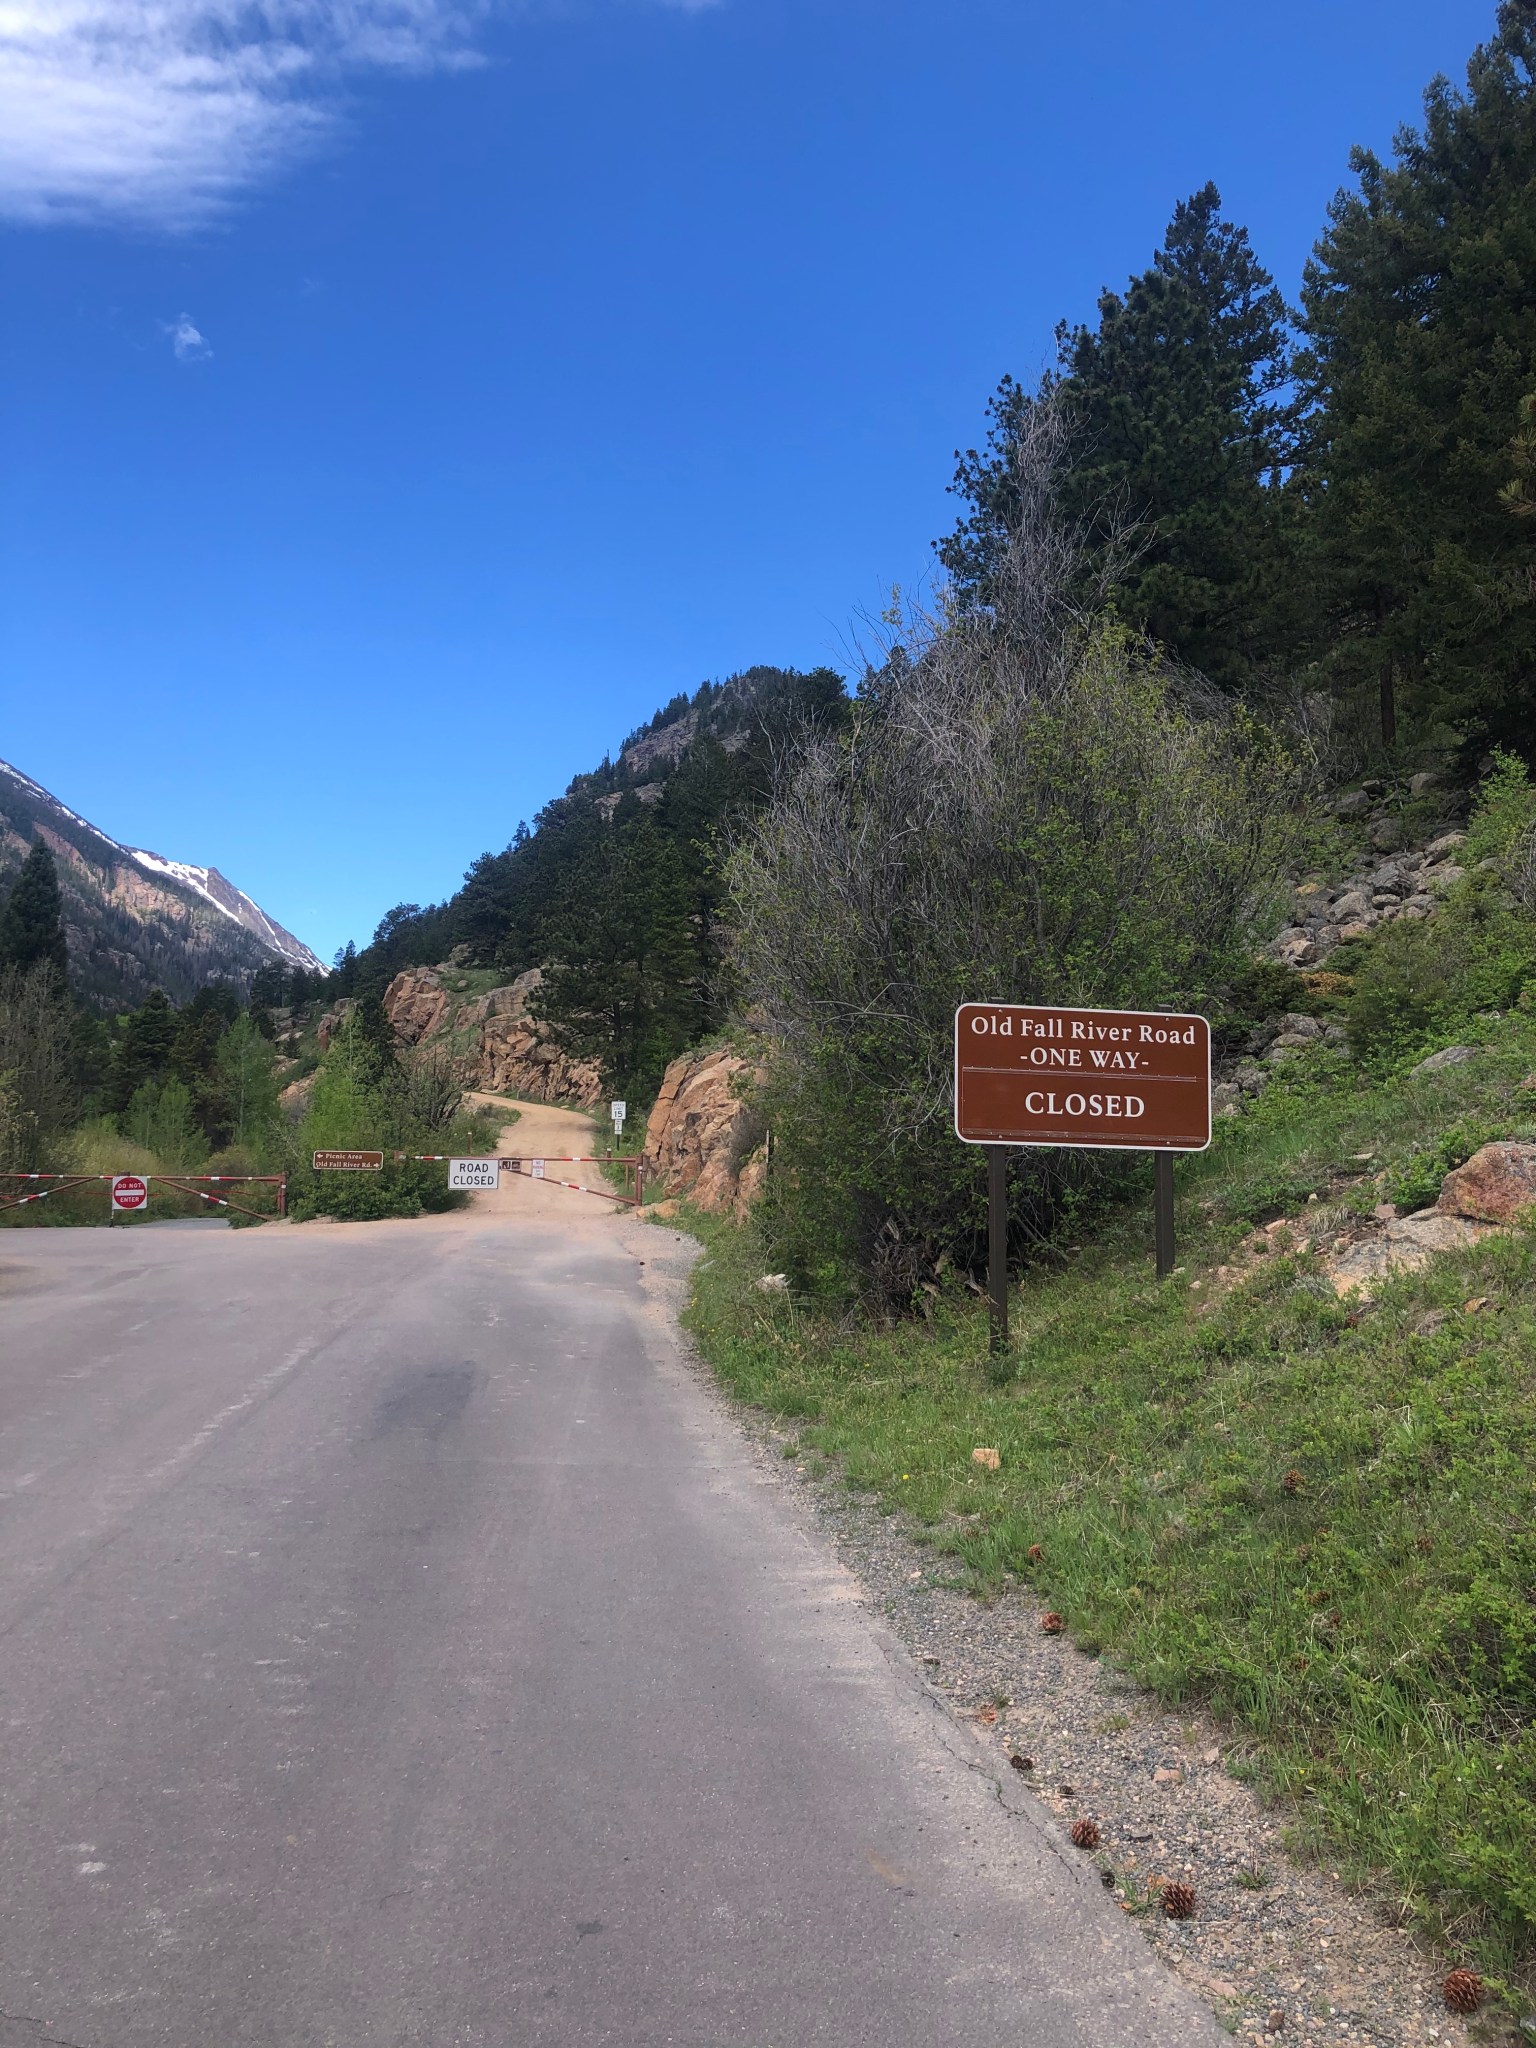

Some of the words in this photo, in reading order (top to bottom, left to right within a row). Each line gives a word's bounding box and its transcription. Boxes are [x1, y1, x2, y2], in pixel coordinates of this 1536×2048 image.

[971, 1016, 1013, 1036] Old
[1021, 1019, 1063, 1039] Fall
[1070, 1021, 1132, 1042] River
[1138, 1025, 1196, 1045] Road
[1025, 1091, 1145, 1118] CLOSED
[459, 1163, 489, 1173] ROAD
[453, 1175, 495, 1185] CLOSED
